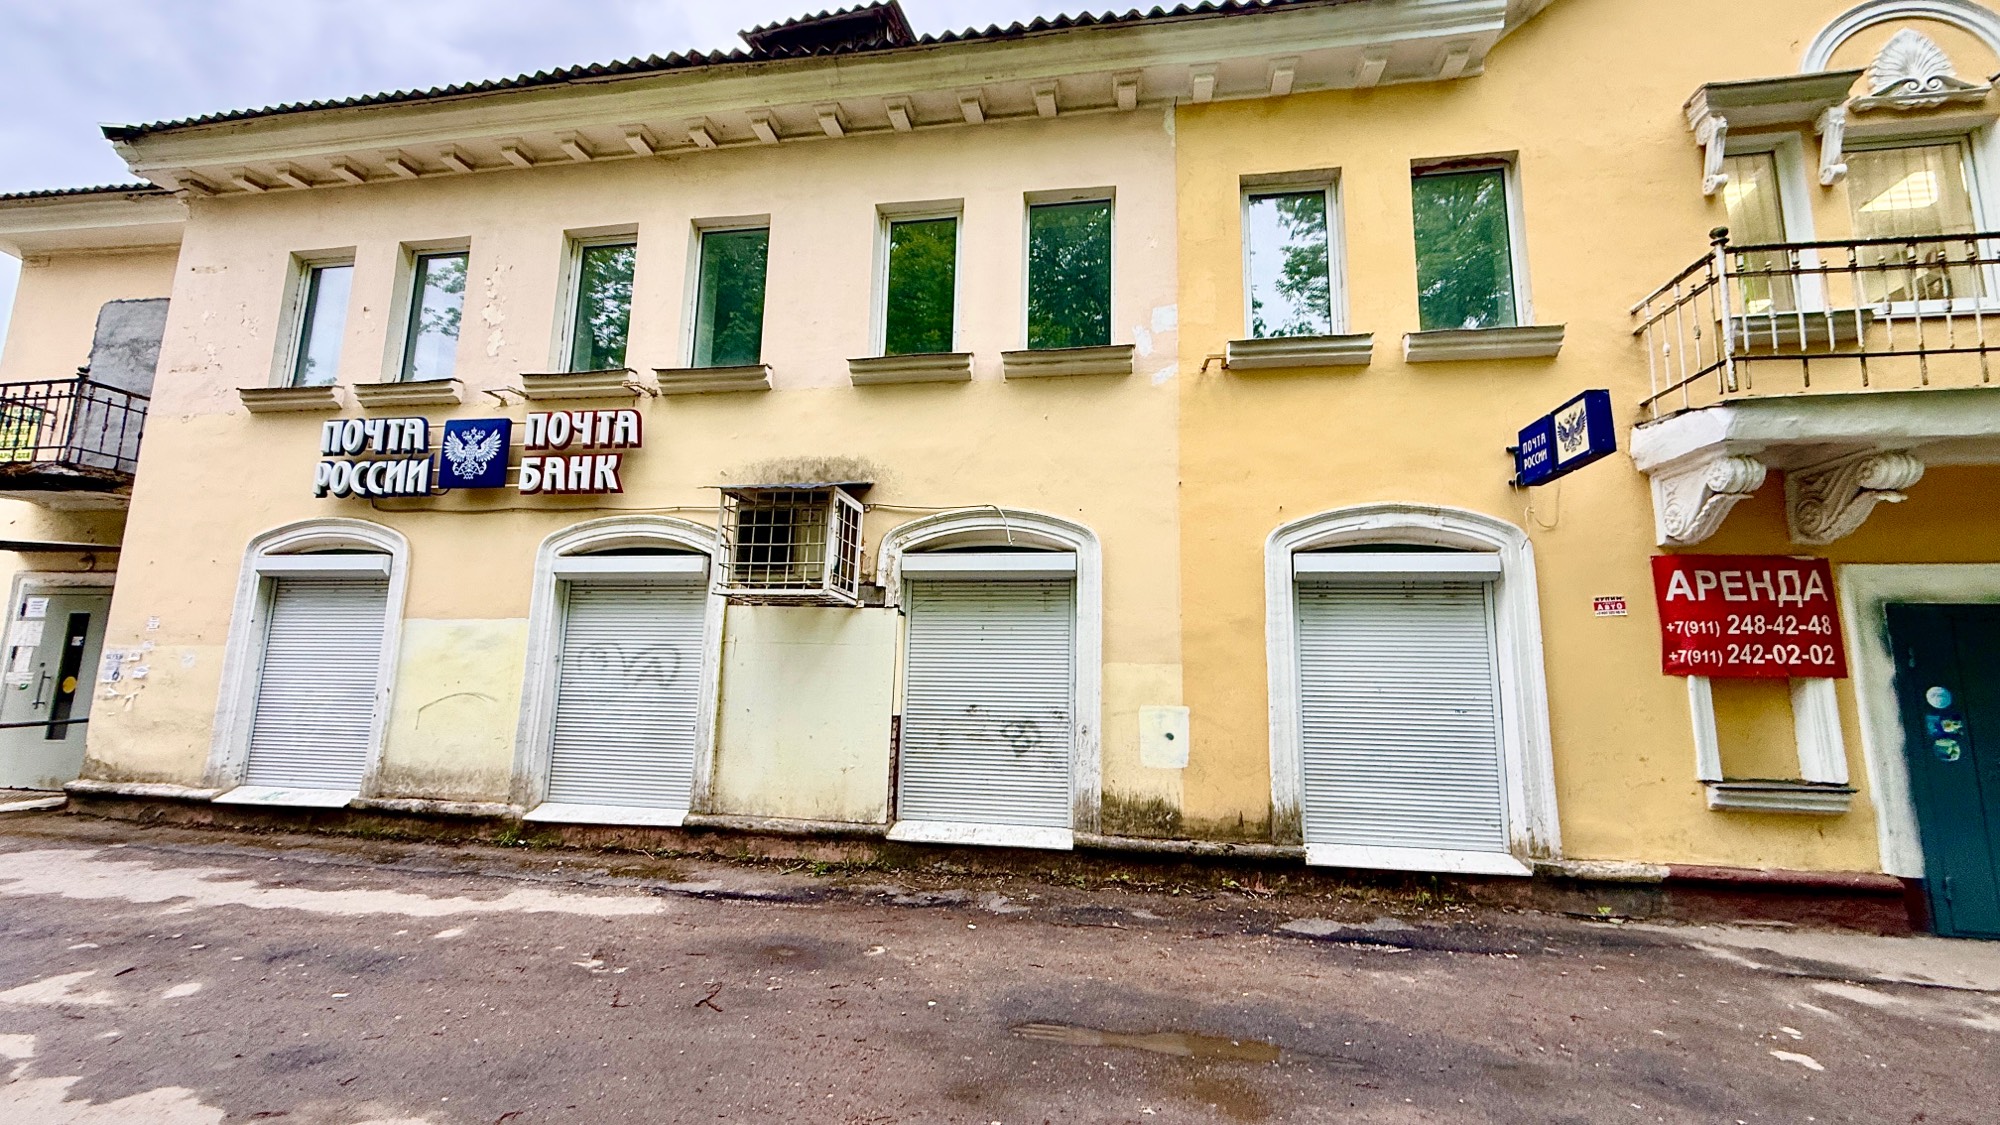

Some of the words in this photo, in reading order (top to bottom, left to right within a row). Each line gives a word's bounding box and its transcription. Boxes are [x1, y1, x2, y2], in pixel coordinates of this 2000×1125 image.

[320, 418, 427, 455] ПОЧТА
[524, 410, 640, 449] ПОЧТА
[1523, 432, 1546, 455] ПОЧТА
[313, 456, 430, 497] РОССИИ
[519, 454, 620, 493] БАНК
[1523, 448, 1547, 470] РОССИИ
[1666, 570, 1828, 607] АРЕНДА
[1666, 620, 1721, 637] +7(911)
[1727, 614, 1832, 636] 248-42-48
[1669, 649, 1723, 667] +7(911)
[1727, 644, 1836, 665] 242-02-02
